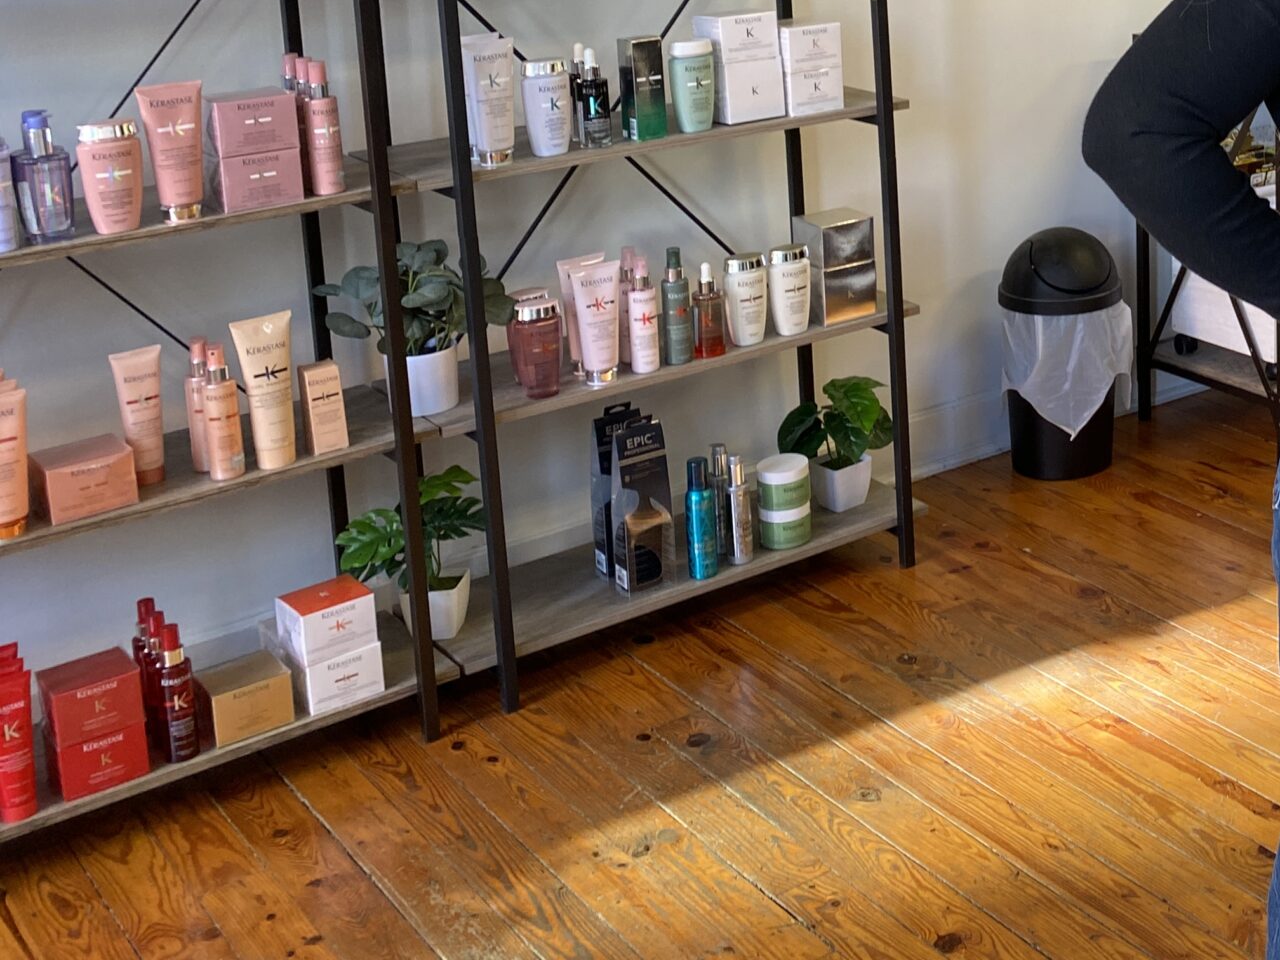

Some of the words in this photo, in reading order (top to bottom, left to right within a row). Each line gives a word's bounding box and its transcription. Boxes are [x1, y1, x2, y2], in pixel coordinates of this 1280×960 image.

[747, 27, 754, 38] K
[813, 39, 820, 48] K
[489, 73, 500, 88] K
[697, 77, 704, 90] K
[814, 82, 821, 92] K
[752, 86, 759, 96] K
[550, 97, 560, 111] K
[595, 296, 606, 311] K
[643, 312, 653, 326] K
[265, 364, 278, 380] K
[605, 422, 625, 435] EPI
[626, 433, 653, 449] EPIC
[336, 619, 346, 632] K
[95, 698, 106, 713] K
[174, 692, 188, 711] K
[4, 720, 20, 741] K
[101, 751, 112, 766] K
